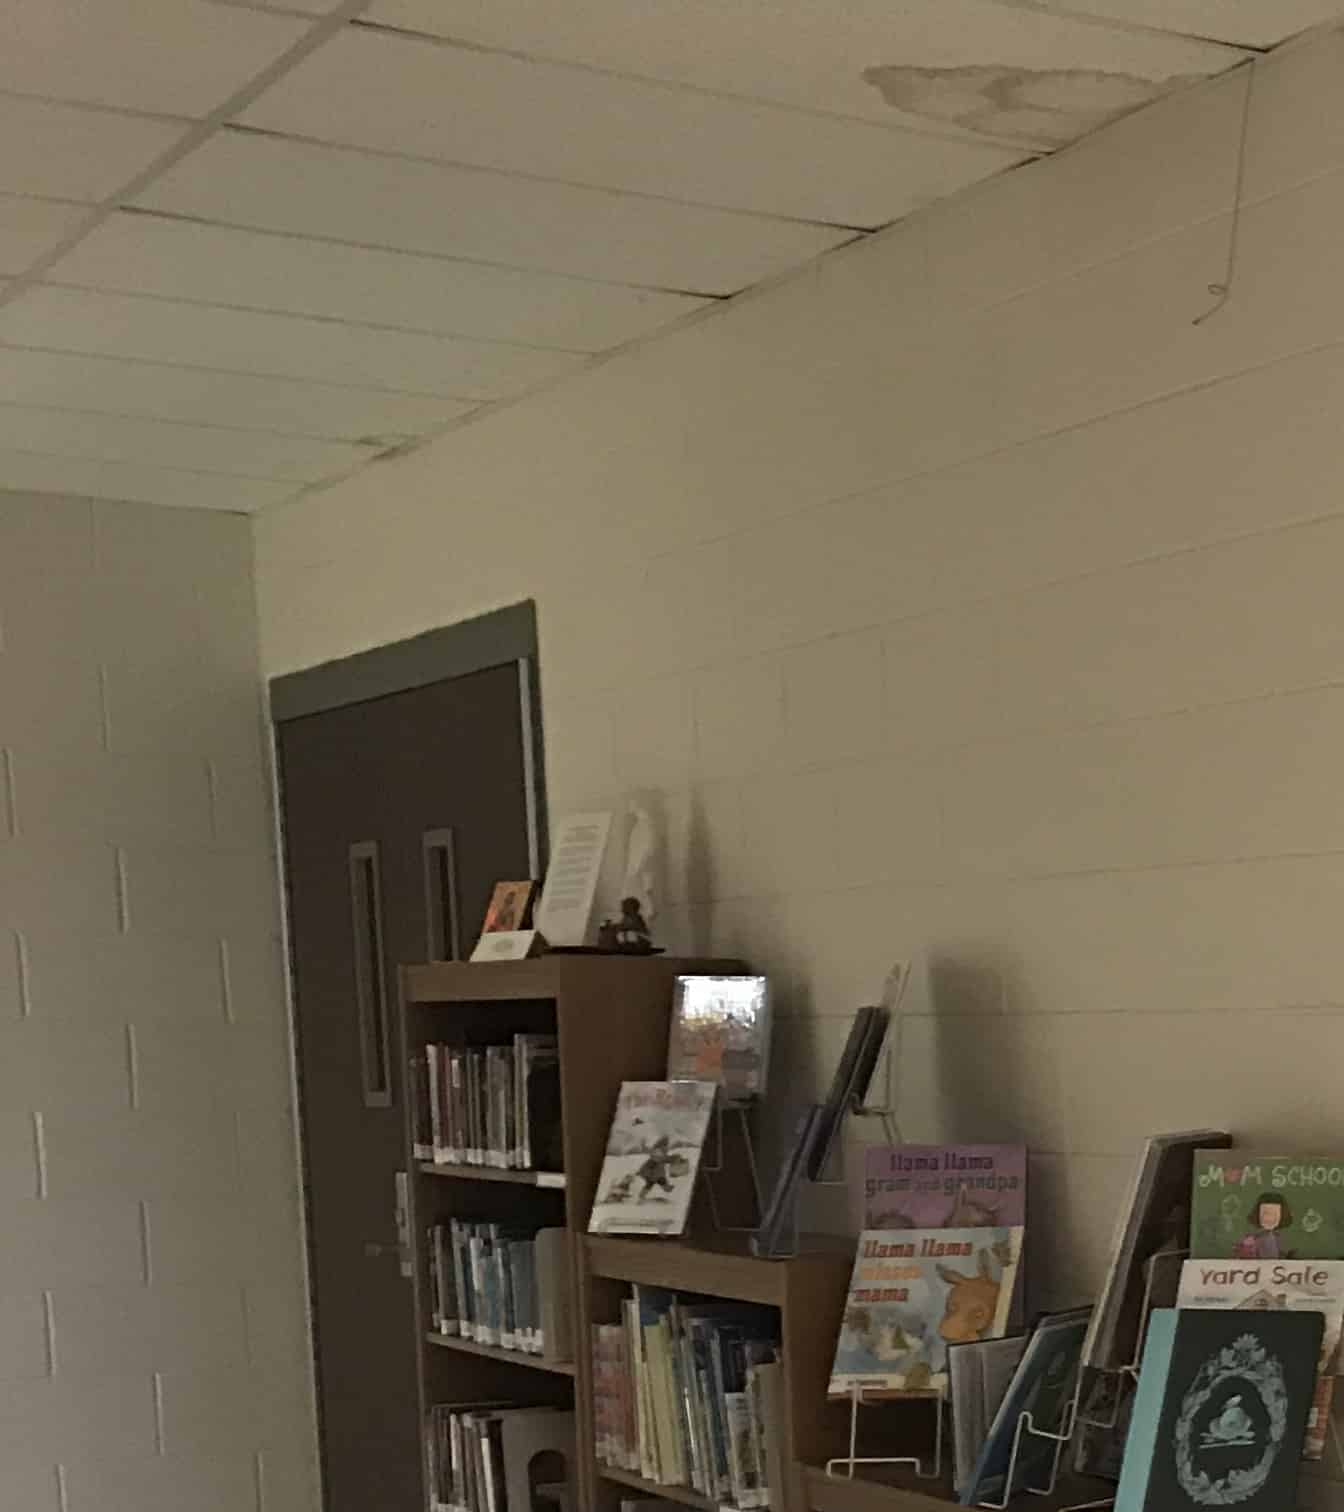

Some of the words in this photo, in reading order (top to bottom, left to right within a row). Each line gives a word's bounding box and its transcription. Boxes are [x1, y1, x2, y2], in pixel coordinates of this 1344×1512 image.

[889, 1153, 939, 1171] llama
[944, 1152, 994, 1170] llama
[863, 1240, 915, 1258] llama
[920, 1238, 973, 1257] llama
[1200, 1265, 1262, 1286] Yard
[1272, 1264, 1329, 1286] Sale
[855, 1288, 908, 1302] mama
